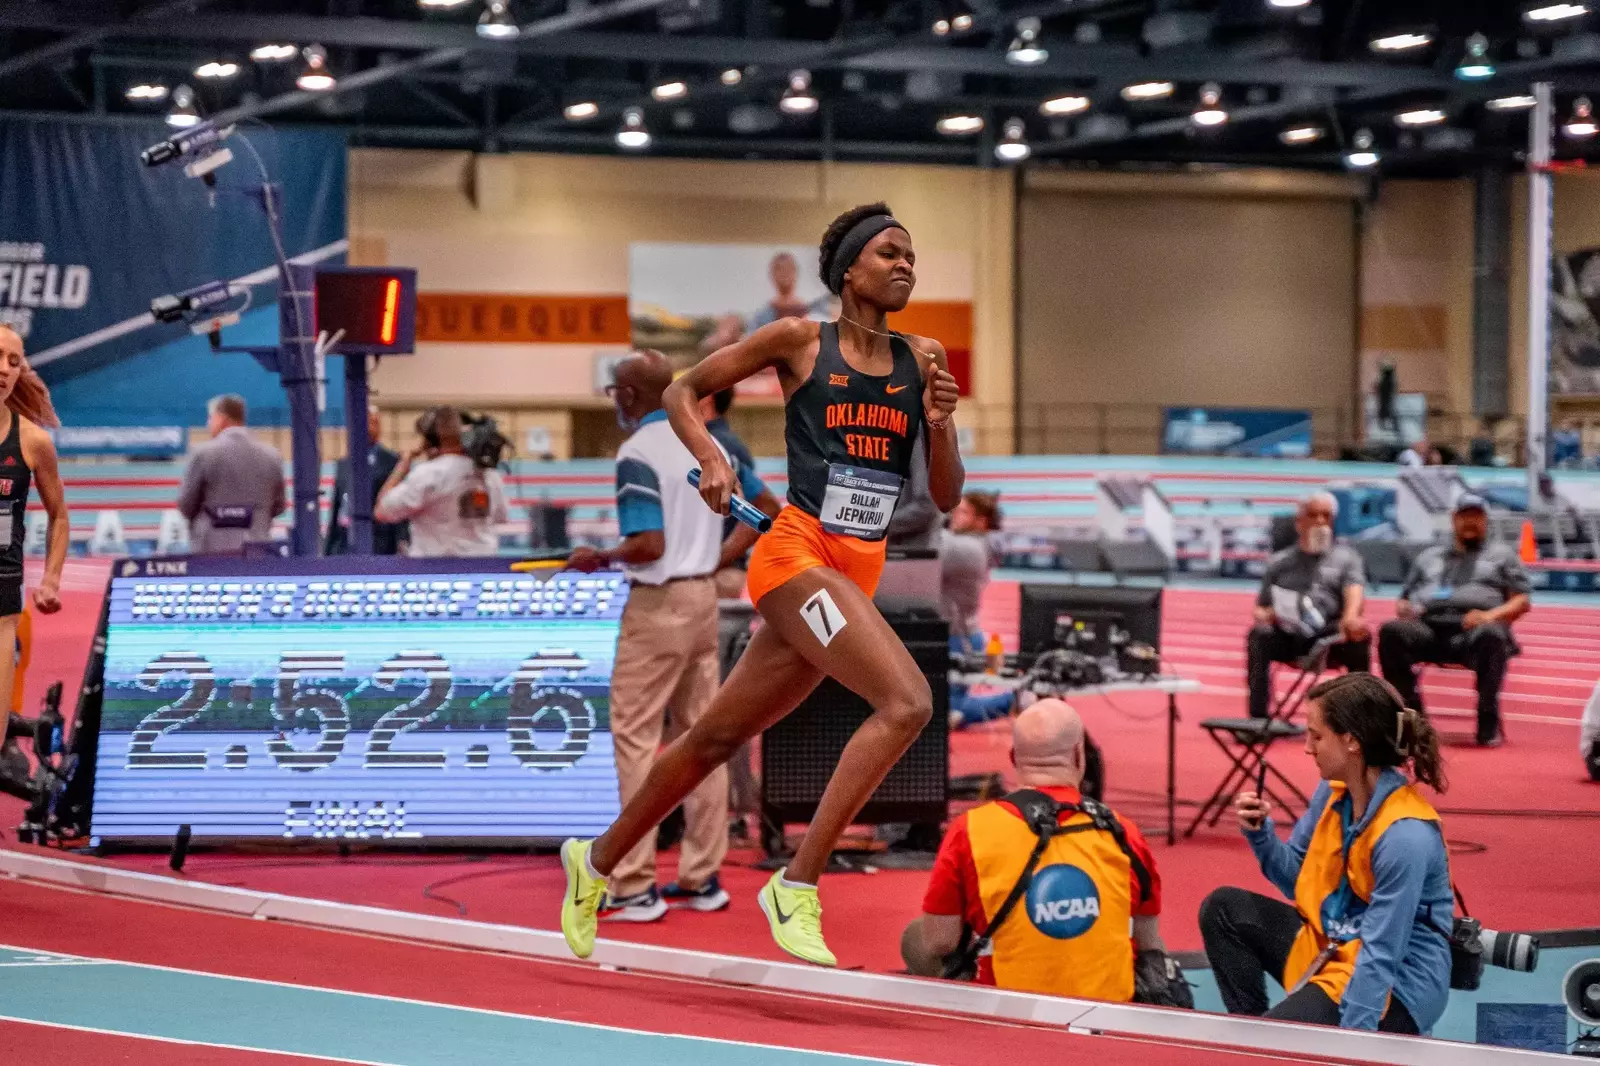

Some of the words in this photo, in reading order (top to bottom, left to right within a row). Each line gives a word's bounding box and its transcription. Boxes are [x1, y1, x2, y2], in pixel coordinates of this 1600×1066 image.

[0, 263, 91, 309] FIELD
[826, 403, 908, 438] OKLAHOMA
[845, 433, 891, 461] STATE
[835, 506, 884, 526] JEPKIRUI
[851, 493, 880, 508] BILLAH
[805, 594, 833, 638] 7
[125, 649, 596, 773] 2:52.6
[283, 800, 423, 838] FINAL
[1034, 896, 1100, 924] NCAA
